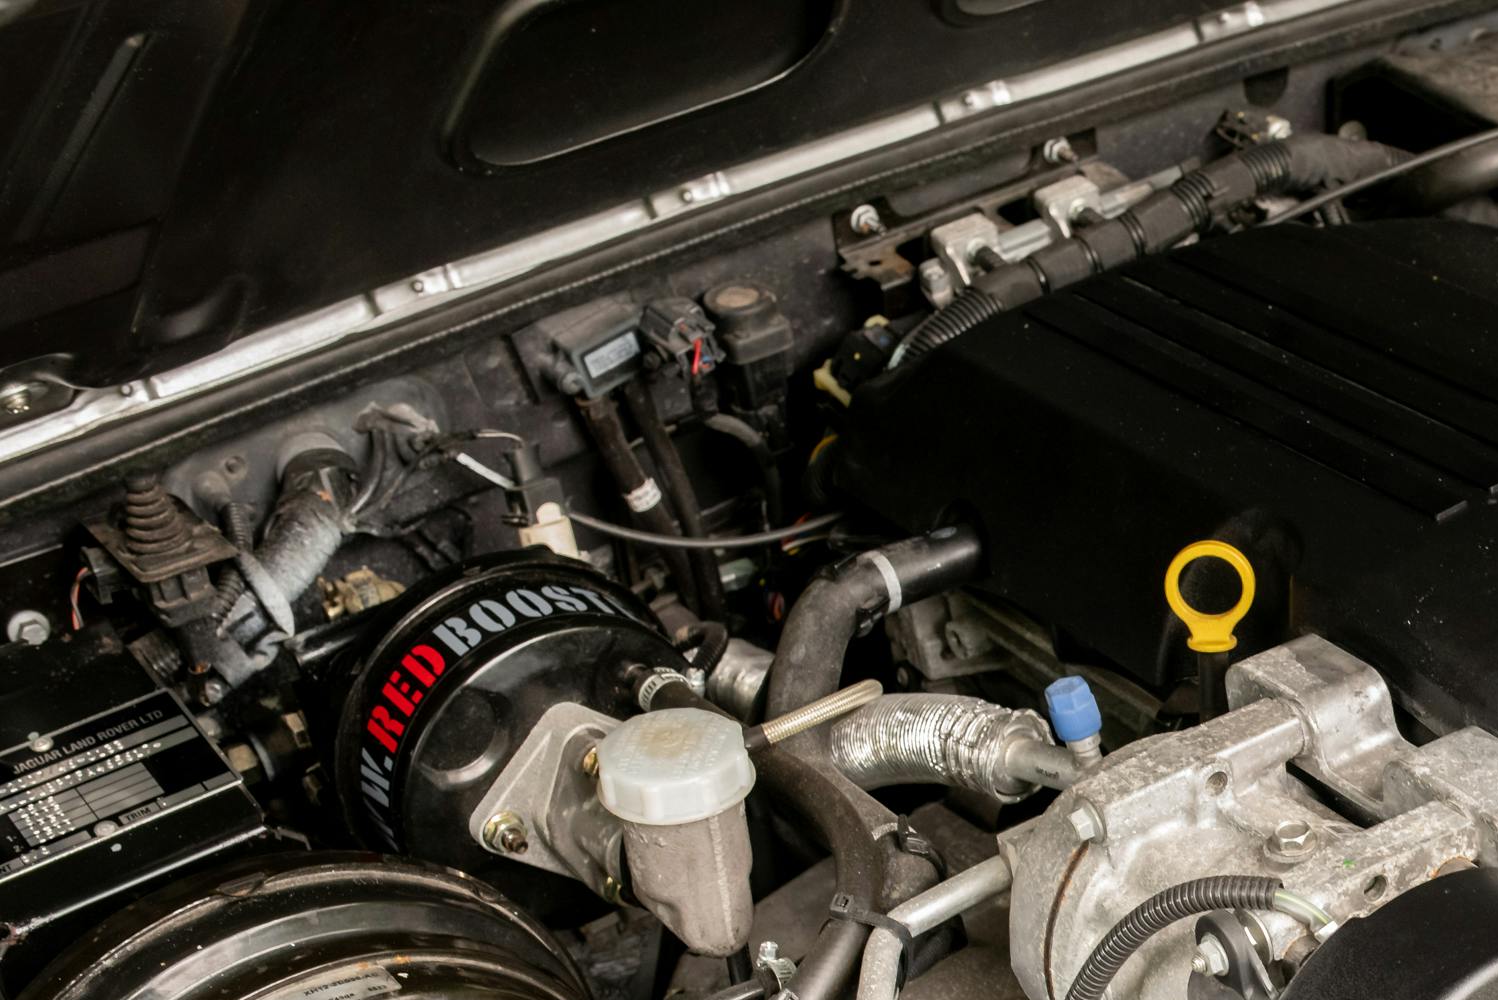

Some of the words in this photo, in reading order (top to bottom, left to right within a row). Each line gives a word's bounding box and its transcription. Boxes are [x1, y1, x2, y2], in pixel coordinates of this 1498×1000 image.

[12, 749, 62, 775] JAGUAR
[62, 735, 97, 755] LAND
[97, 718, 138, 741] ROVER
[140, 709, 164, 725] LTD
